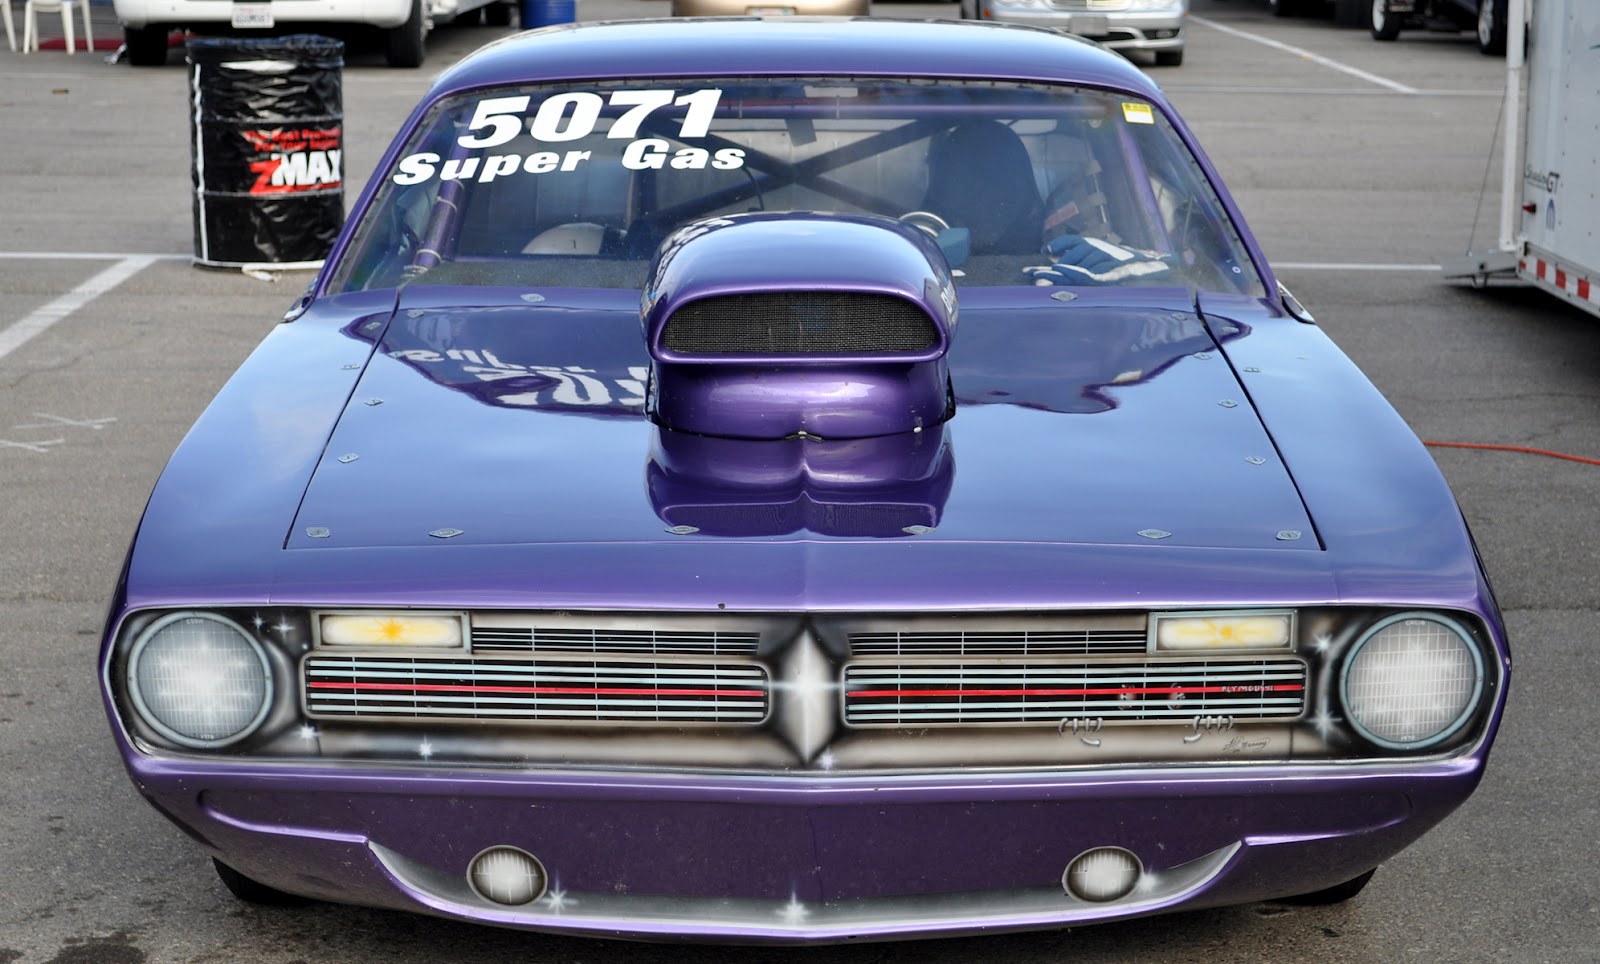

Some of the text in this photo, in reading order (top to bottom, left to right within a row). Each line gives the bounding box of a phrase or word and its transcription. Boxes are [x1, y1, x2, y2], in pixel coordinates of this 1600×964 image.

[457, 89, 722, 149] 5071
[393, 139, 746, 186] Super Gas
